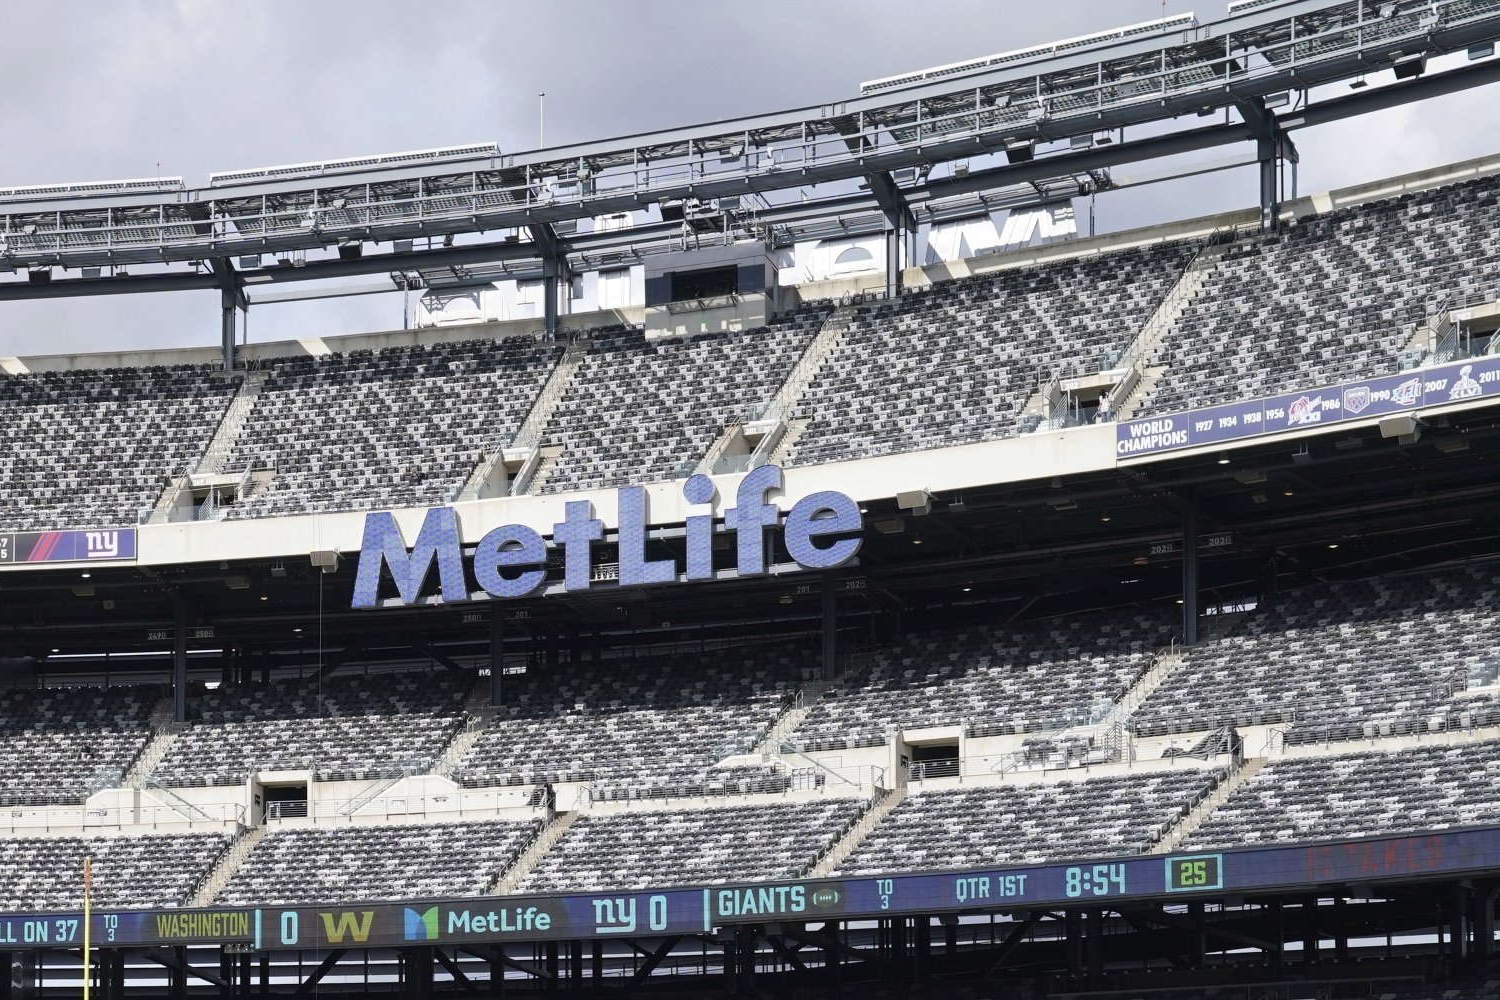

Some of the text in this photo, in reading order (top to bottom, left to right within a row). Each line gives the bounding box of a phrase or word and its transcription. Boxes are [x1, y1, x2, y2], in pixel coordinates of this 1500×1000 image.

[1195, 421, 1213, 432] 1927
[1219, 417, 1237, 428] 1934
[1243, 413, 1261, 424] 1938
[1266, 408, 1284, 420] 1956
[1322, 398, 1340, 411] 1986
[1370, 389, 1390, 402] 1990
[1425, 379, 1447, 392] 2007
[1479, 370, 1500, 383] 2011
[1130, 420, 1174, 437] WORLD
[1117, 431, 1187, 453] CHAMPIONS
[350, 465, 865, 609] MetLife
[1065, 864, 1127, 897] 8:54
[1180, 861, 1207, 886] 25
[876, 879, 893, 895] TO
[956, 874, 1027, 902] QTR 1ST
[718, 886, 806, 917] GIANTS
[880, 895, 889, 910] 3
[24, 920, 48, 943] ON
[55, 920, 78, 942] 37
[104, 914, 118, 928] TO
[156, 912, 249, 938] WASHINGTON
[447, 906, 551, 934] MetLife
[107, 928, 115, 942] 3
